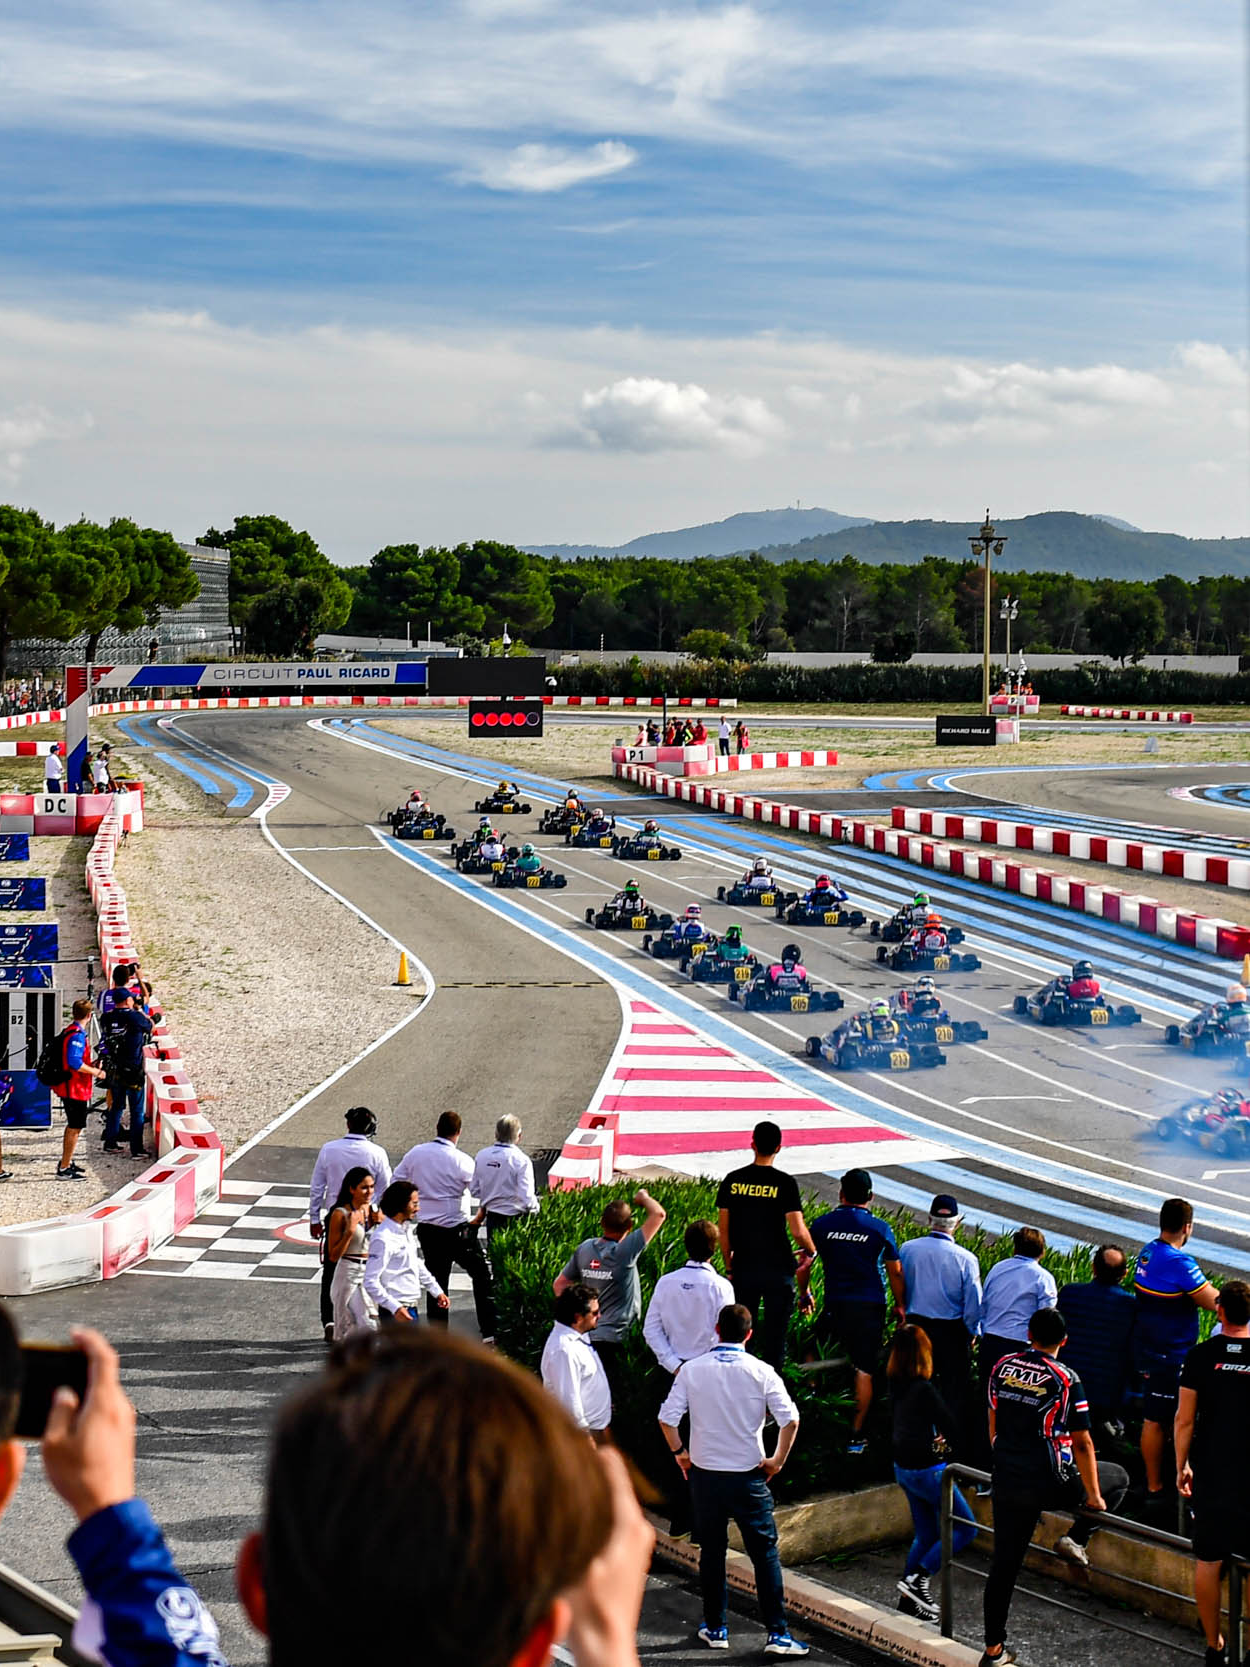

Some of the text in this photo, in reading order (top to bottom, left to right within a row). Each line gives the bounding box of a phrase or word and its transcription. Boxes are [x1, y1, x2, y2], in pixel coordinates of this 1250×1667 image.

[213, 667, 390, 680] CIRCUIT PAUL RICARD
[792, 998, 807, 1010] 205
[11, 1015, 24, 1025] B2
[730, 1182, 779, 1198] SWEDEN
[826, 1231, 869, 1243] FADECH
[581, 1268, 614, 1280] DENMARK
[998, 1363, 1052, 1386] FMV
